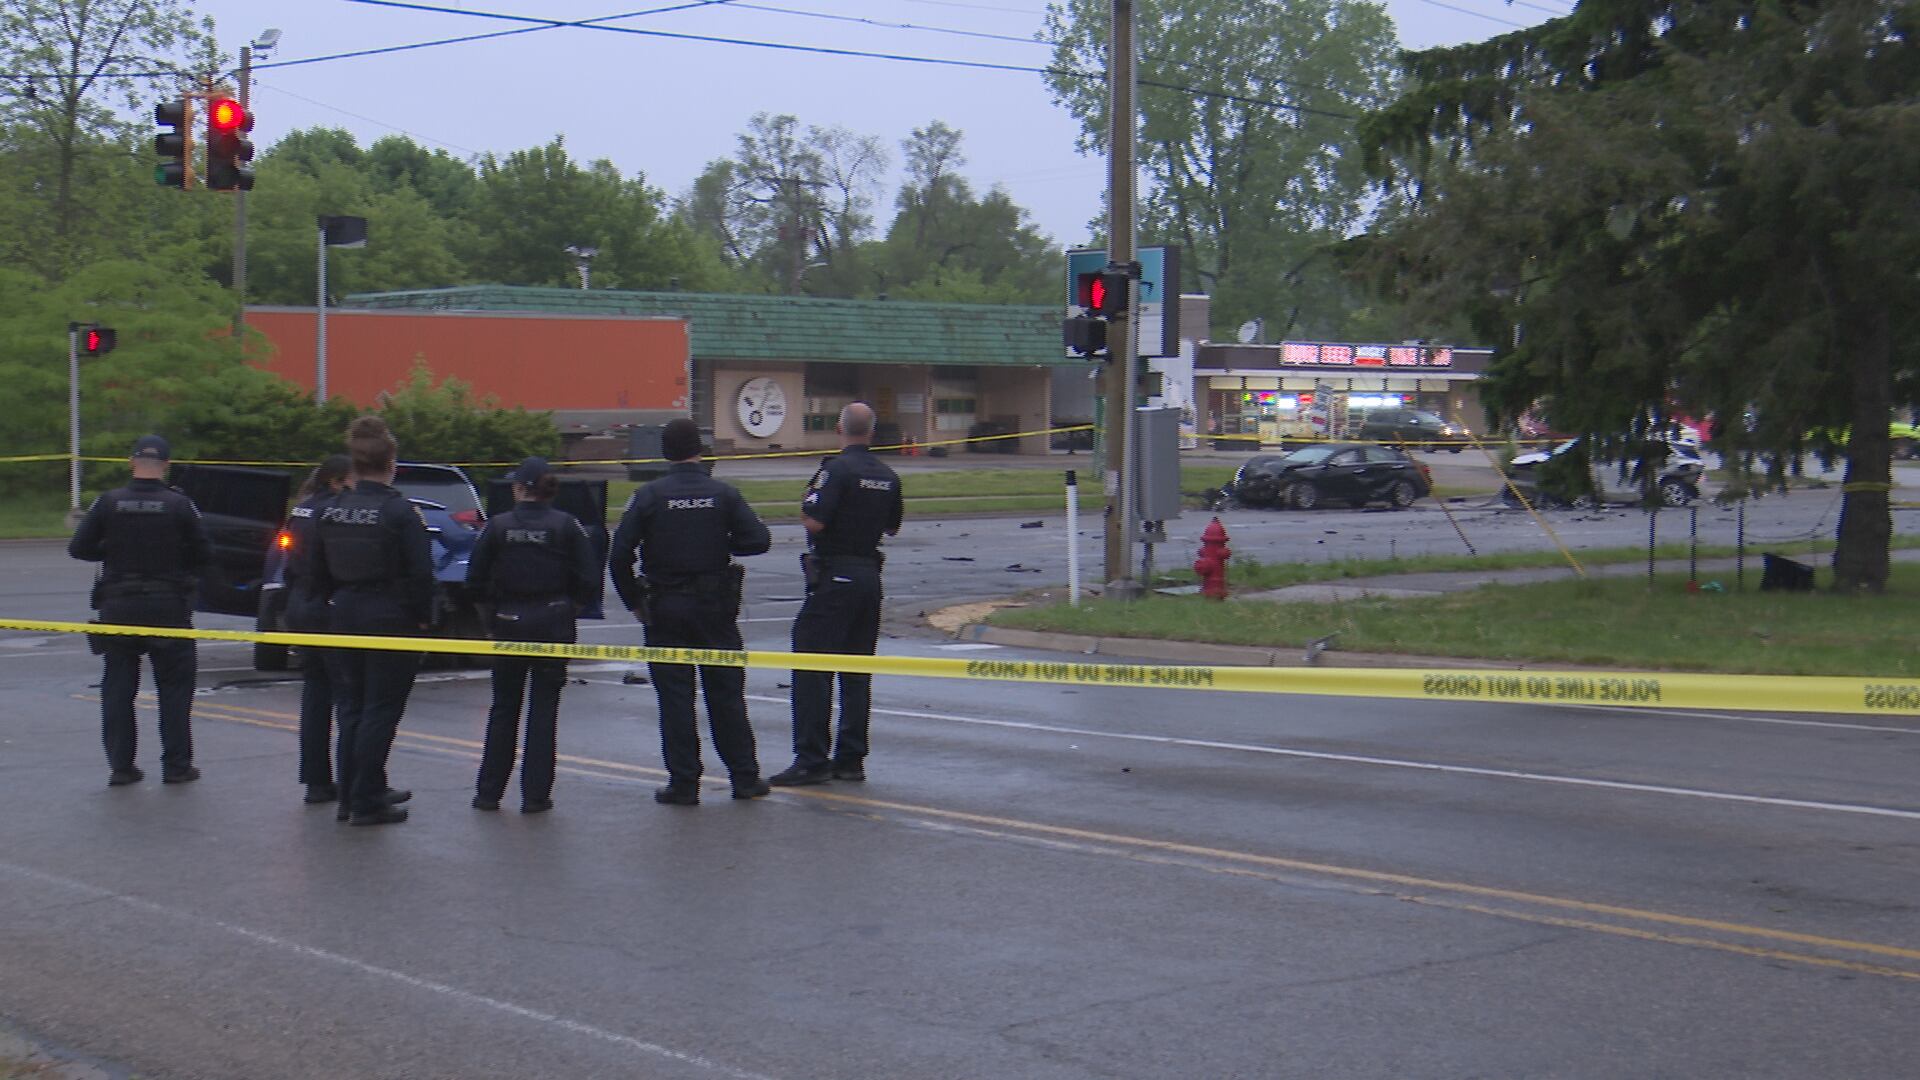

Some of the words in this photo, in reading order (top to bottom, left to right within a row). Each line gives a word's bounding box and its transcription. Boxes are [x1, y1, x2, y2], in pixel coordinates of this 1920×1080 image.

[1321, 345, 1352, 365] BEER
[1389, 346, 1418, 367] WINE
[860, 478, 892, 491] POLICE
[667, 497, 714, 510] POLICE
[321, 506, 379, 525] POLICE
